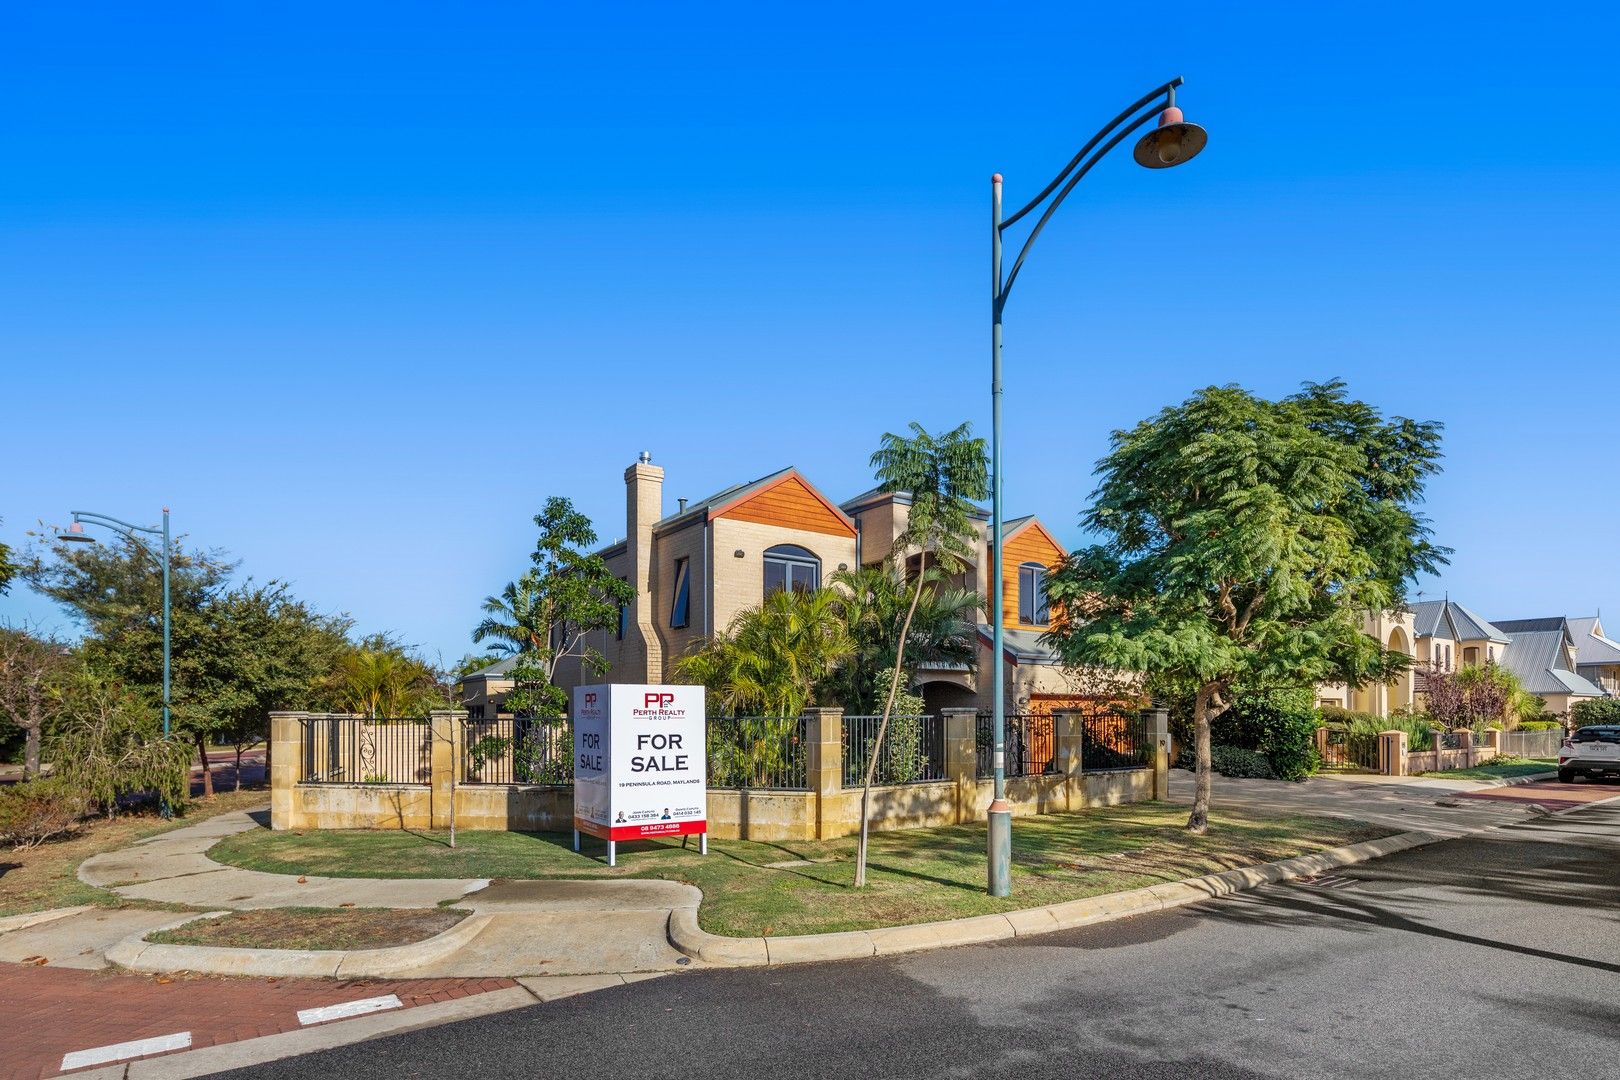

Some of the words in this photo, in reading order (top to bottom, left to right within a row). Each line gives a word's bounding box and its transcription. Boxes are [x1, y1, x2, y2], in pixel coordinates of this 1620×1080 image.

[582, 733, 600, 749] FOR
[637, 734, 683, 750] FOR
[580, 754, 602, 771] SALE
[631, 755, 688, 772] SALE
